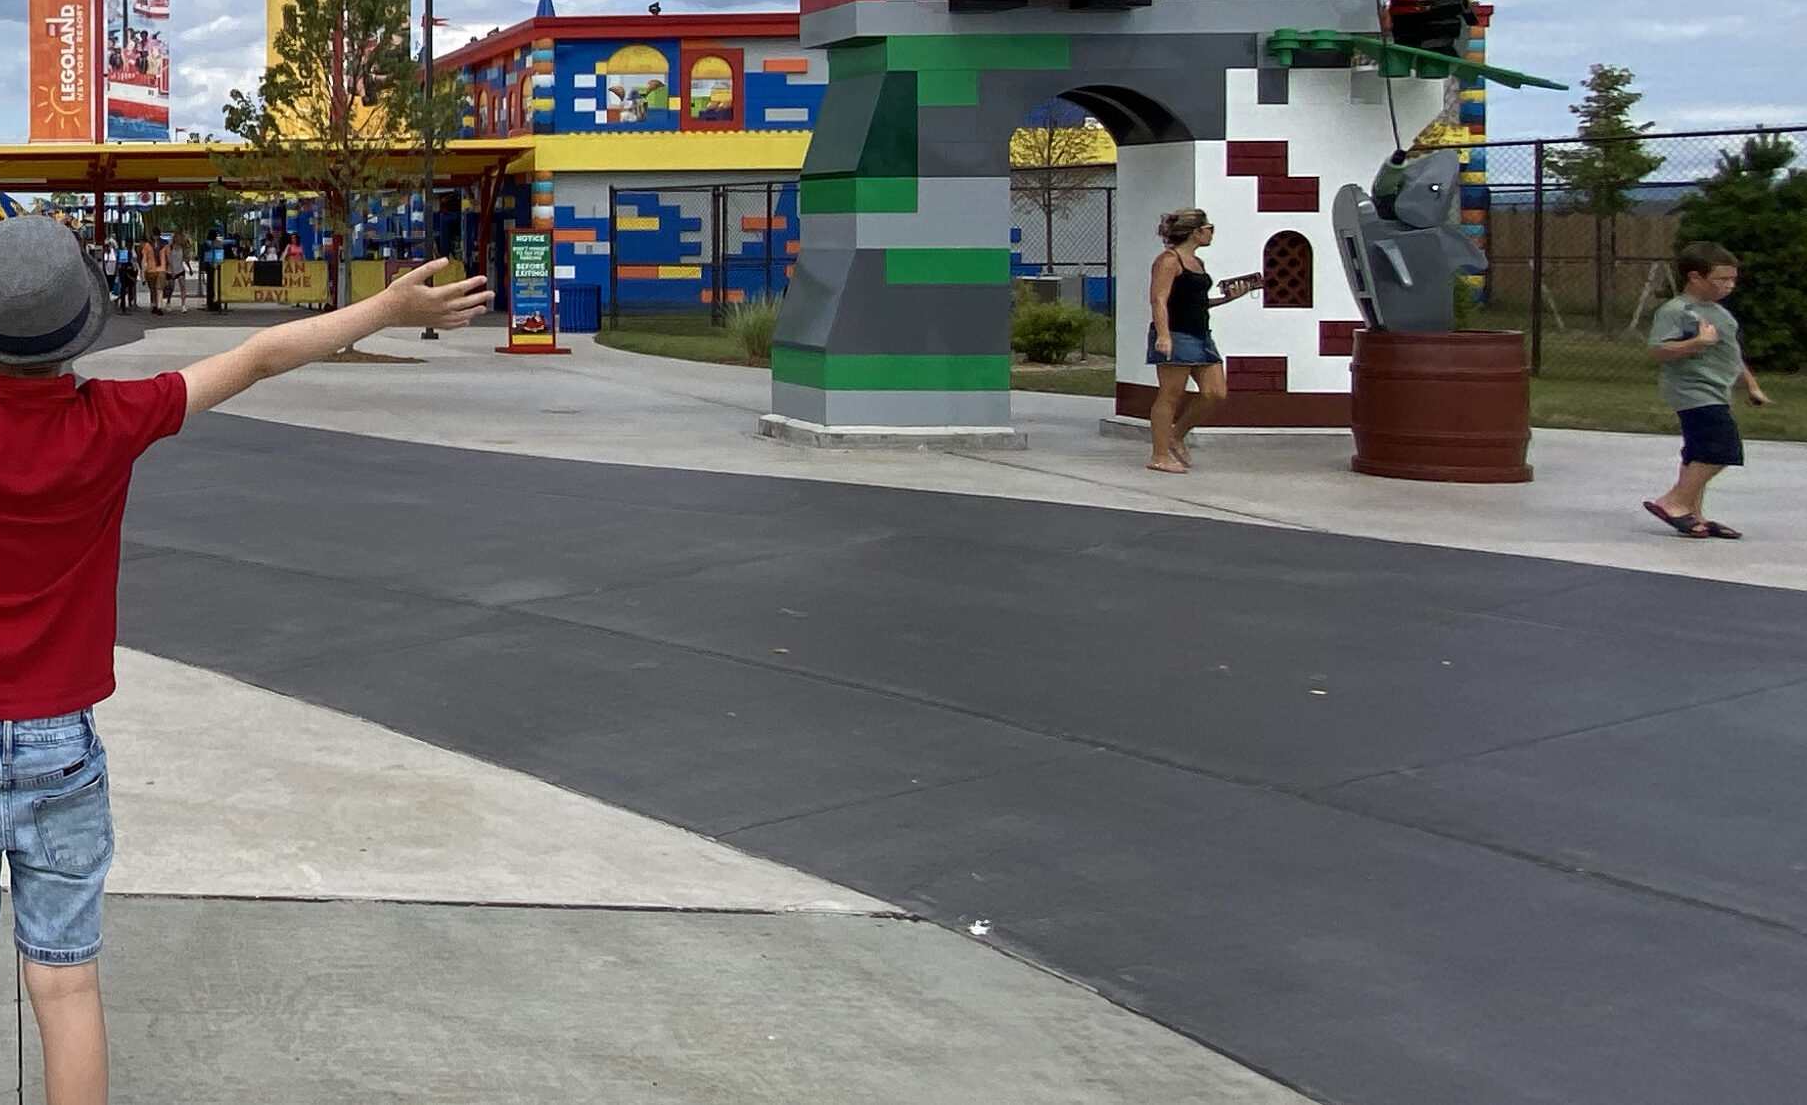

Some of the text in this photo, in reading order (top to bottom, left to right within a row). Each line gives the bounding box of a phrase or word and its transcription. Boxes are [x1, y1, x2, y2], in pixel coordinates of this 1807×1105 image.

[45, 4, 76, 102] LEGOLAND
[284, 262, 306, 273] AN
[231, 276, 312, 288] AWOME
[254, 289, 289, 302] DAY!
